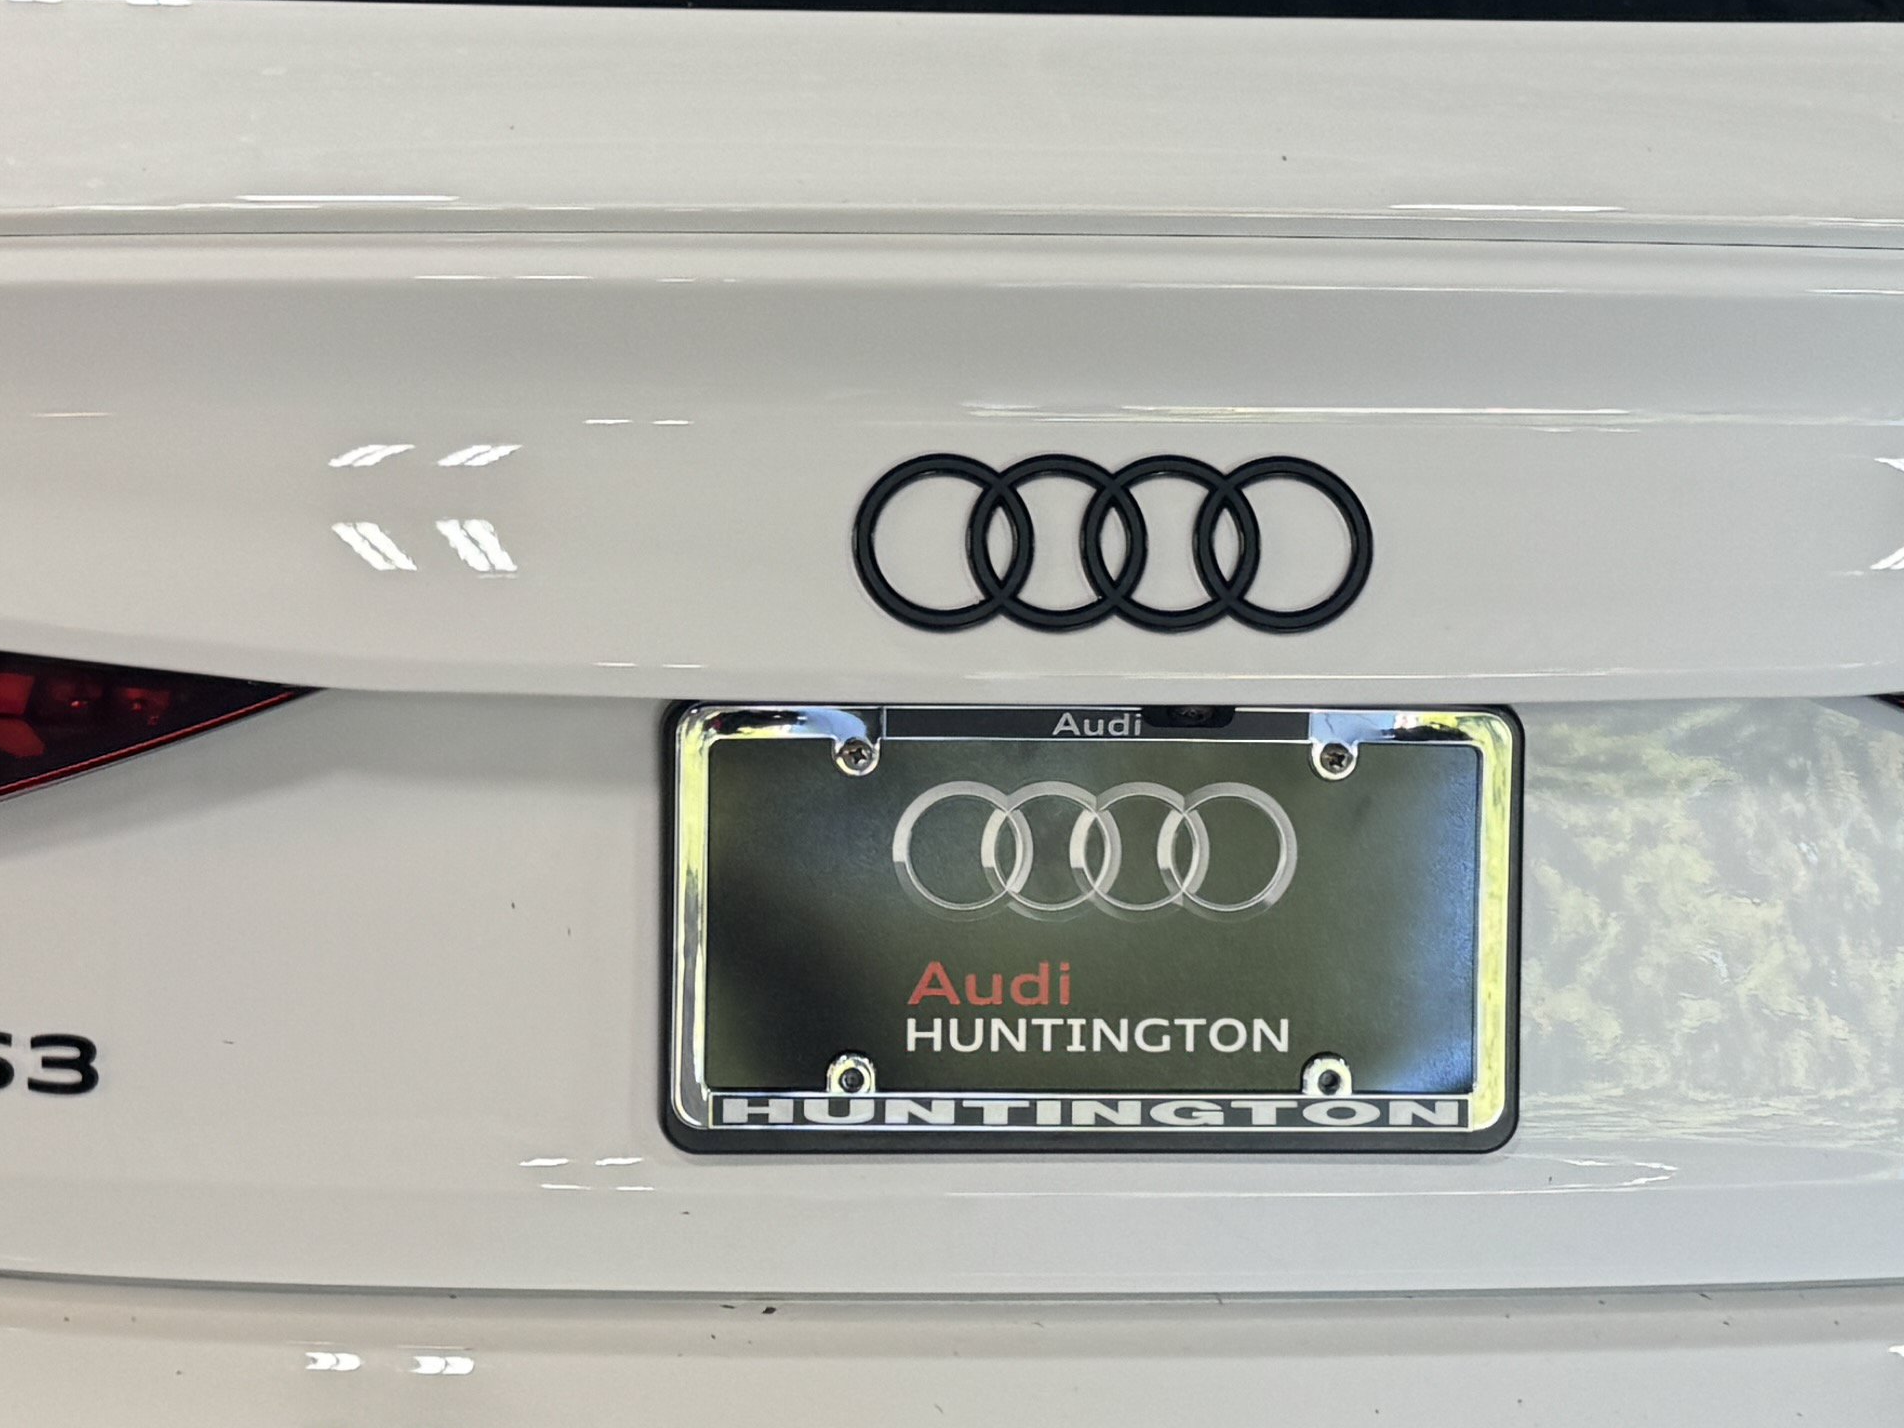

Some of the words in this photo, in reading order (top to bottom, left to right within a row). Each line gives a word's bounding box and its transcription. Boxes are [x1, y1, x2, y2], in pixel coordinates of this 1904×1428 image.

[1052, 712, 1142, 736] Audi
[907, 960, 1071, 1006] Audi
[906, 1017, 1289, 1053] HUNTINGTON
[721, 1099, 1460, 1128] HUNTINGTON
